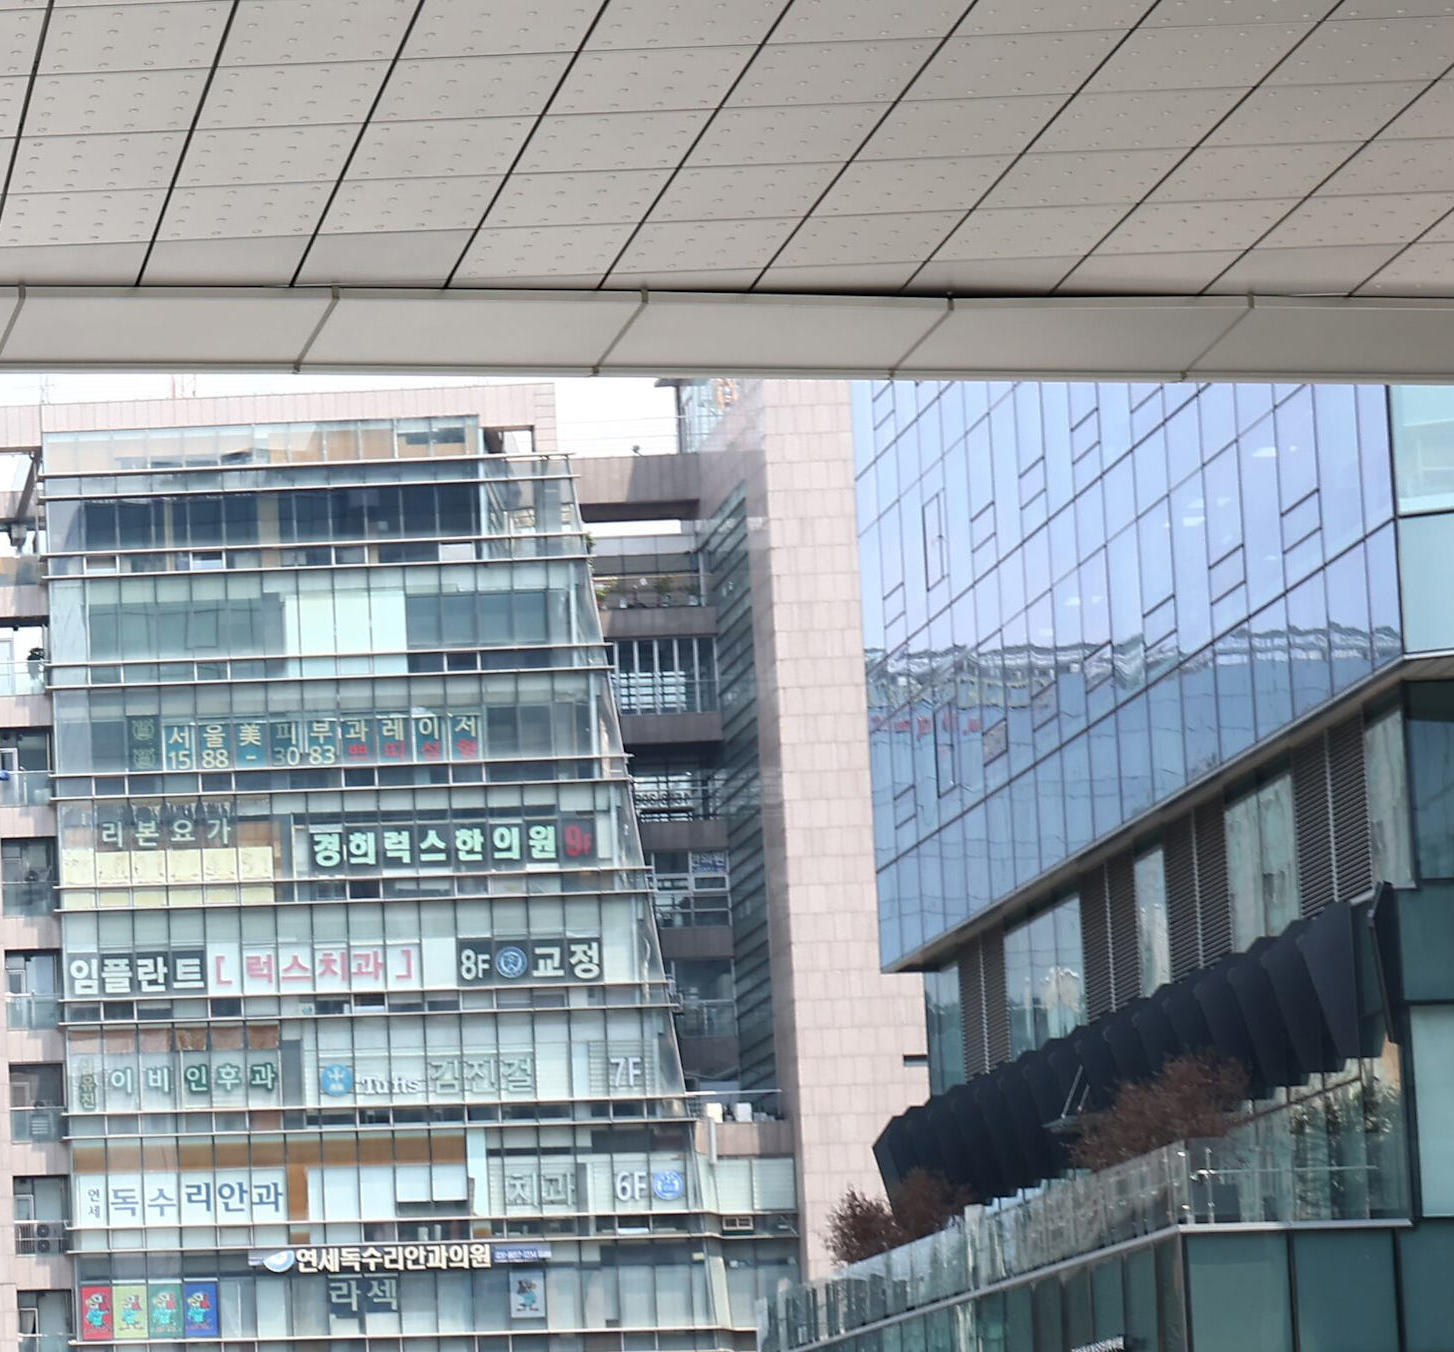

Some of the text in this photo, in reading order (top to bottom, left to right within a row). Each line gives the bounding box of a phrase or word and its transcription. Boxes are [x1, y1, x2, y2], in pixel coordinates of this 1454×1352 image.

[101, 816, 232, 848] 리본요가
[69, 955, 205, 995] 임플란트
[460, 942, 601, 982] 8F 교정
[110, 1062, 278, 1096] 이비인후과
[610, 1056, 643, 1089] 7F
[110, 1181, 284, 1218] 독수리안과
[505, 1172, 574, 1207] 치과
[615, 1172, 648, 1201] 6F
[296, 1243, 492, 1274] 연세독수리안과의원
[329, 1275, 399, 1312] 라섹
